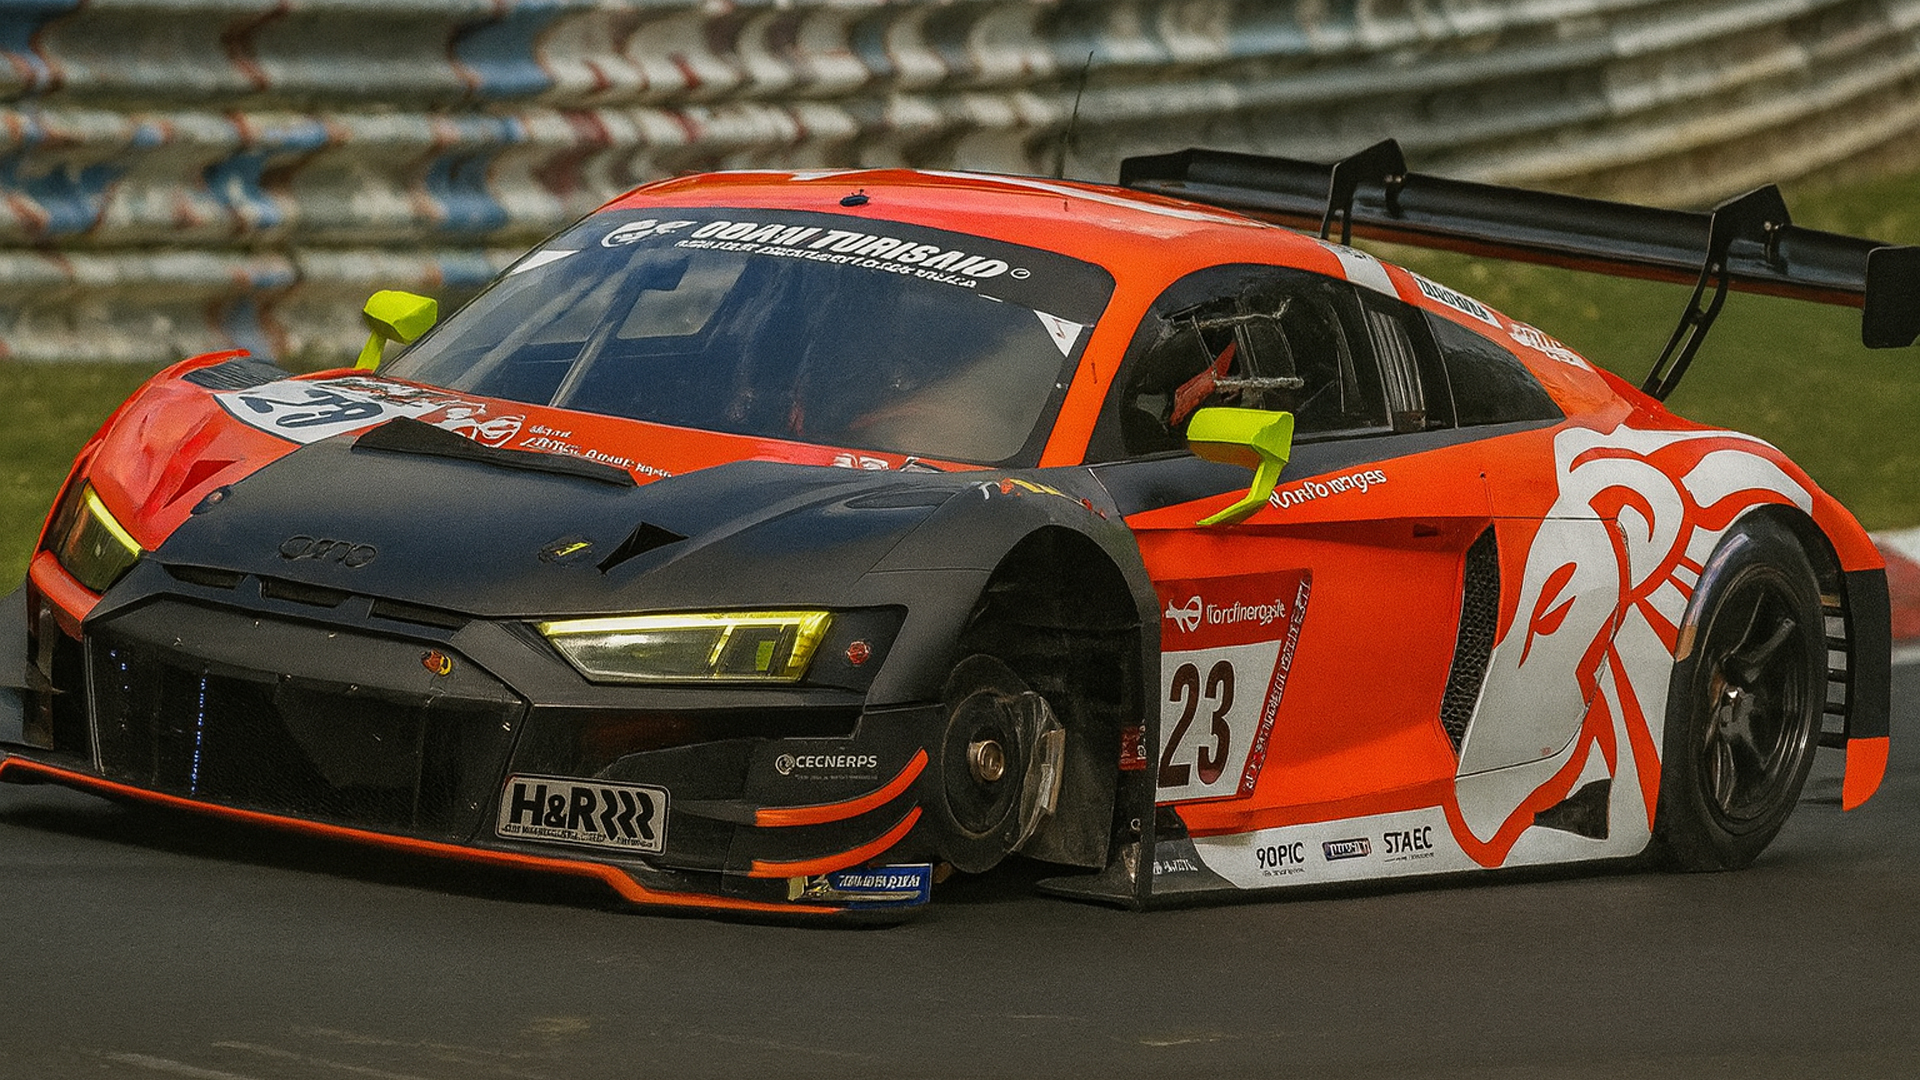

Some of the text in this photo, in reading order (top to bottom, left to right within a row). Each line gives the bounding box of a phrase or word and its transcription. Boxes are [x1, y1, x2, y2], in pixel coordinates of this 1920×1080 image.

[1157, 660, 1236, 788] 23
[796, 754, 878, 769] CECNERPS
[509, 783, 600, 833] H&R
[1383, 826, 1434, 854] STAEC
